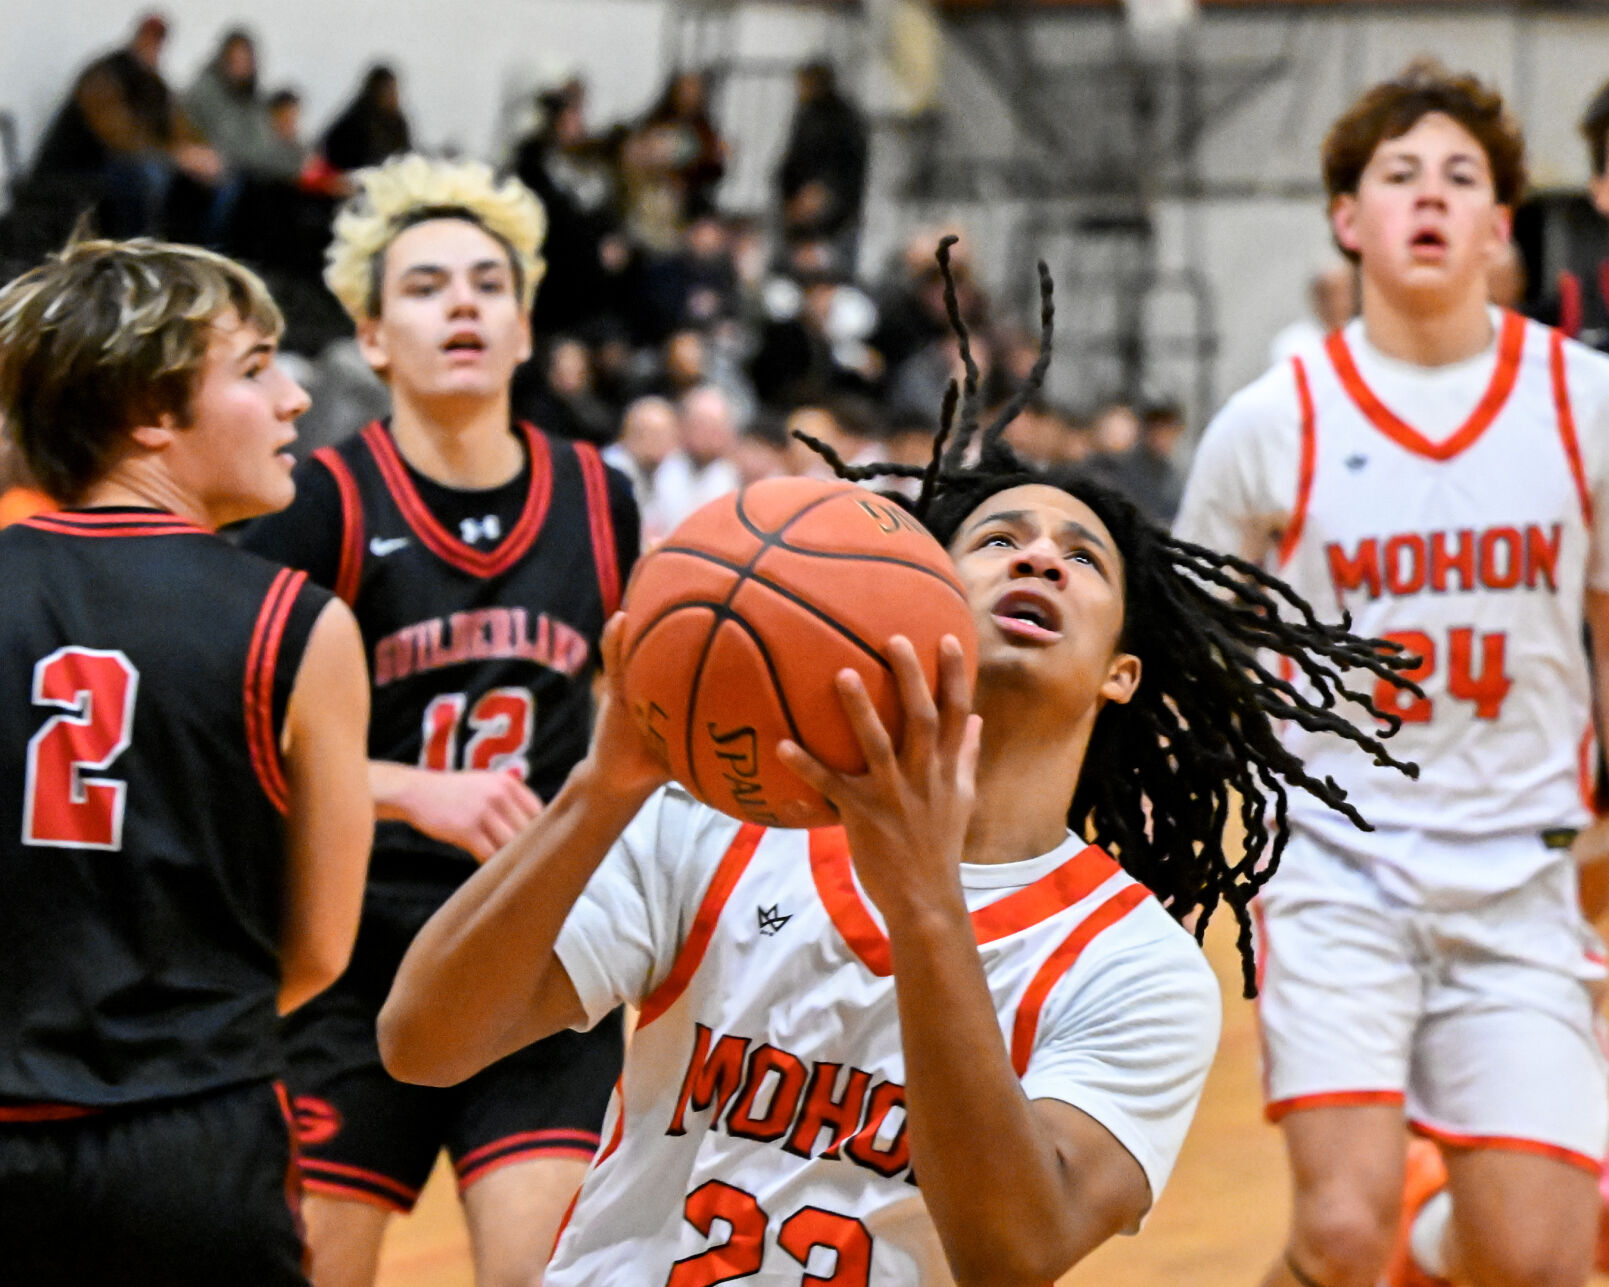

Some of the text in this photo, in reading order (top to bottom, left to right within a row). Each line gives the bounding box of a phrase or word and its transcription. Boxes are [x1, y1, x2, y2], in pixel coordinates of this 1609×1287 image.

[1326, 523, 1562, 610] MOHON
[1372, 626, 1512, 724] 24
[22, 645, 139, 852] 2
[418, 686, 535, 780] 12
[664, 1021, 920, 1187] MOHO
